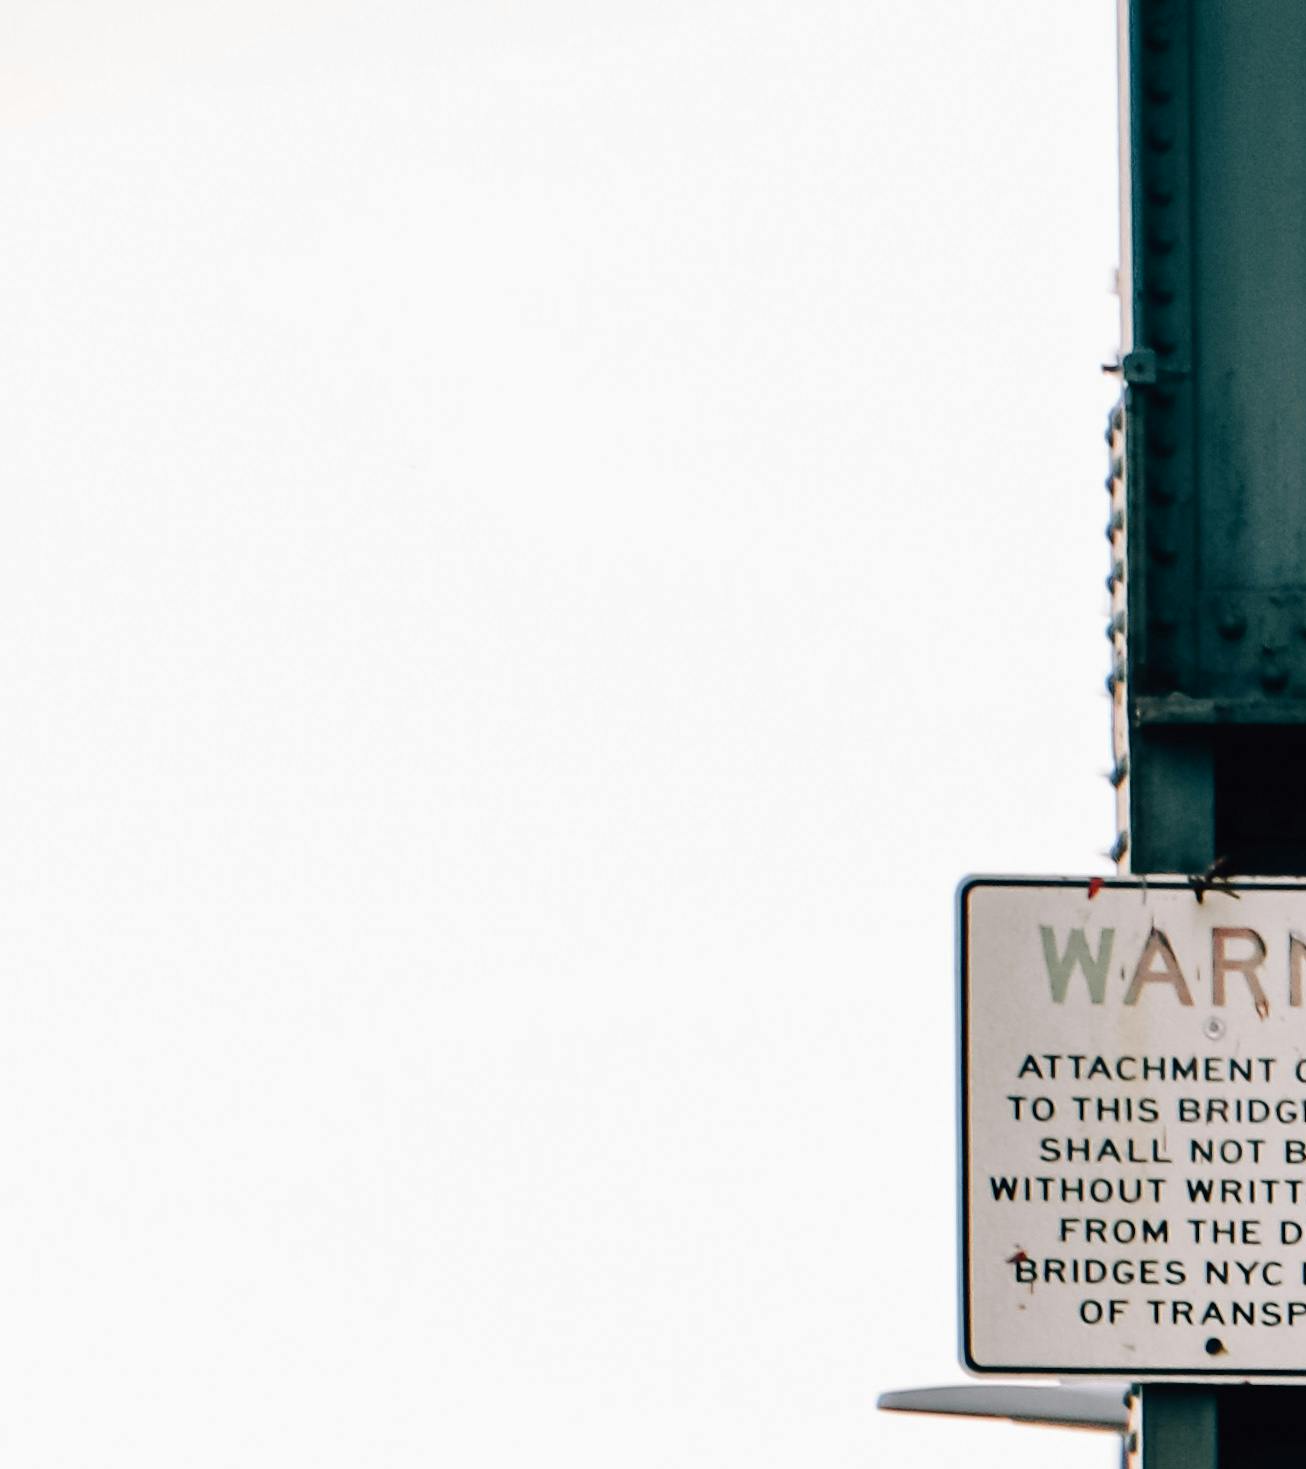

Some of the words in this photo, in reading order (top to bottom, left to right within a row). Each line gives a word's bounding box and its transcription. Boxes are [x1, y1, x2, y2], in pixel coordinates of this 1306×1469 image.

[1018, 1054, 1276, 1083] ATTACHMENT
[1006, 1096, 1055, 1122] TO
[1072, 1096, 1159, 1122] THIS
[1039, 1138, 1172, 1164] SHALL
[1190, 1139, 1265, 1164] NOT
[990, 1177, 1166, 1204] WITHOUT
[1060, 1219, 1169, 1244] FROM
[1187, 1220, 1261, 1245] THE
[1014, 1259, 1186, 1286] BRIDGES
[1206, 1261, 1282, 1287] NYC
[1079, 1299, 1129, 1325] OF
